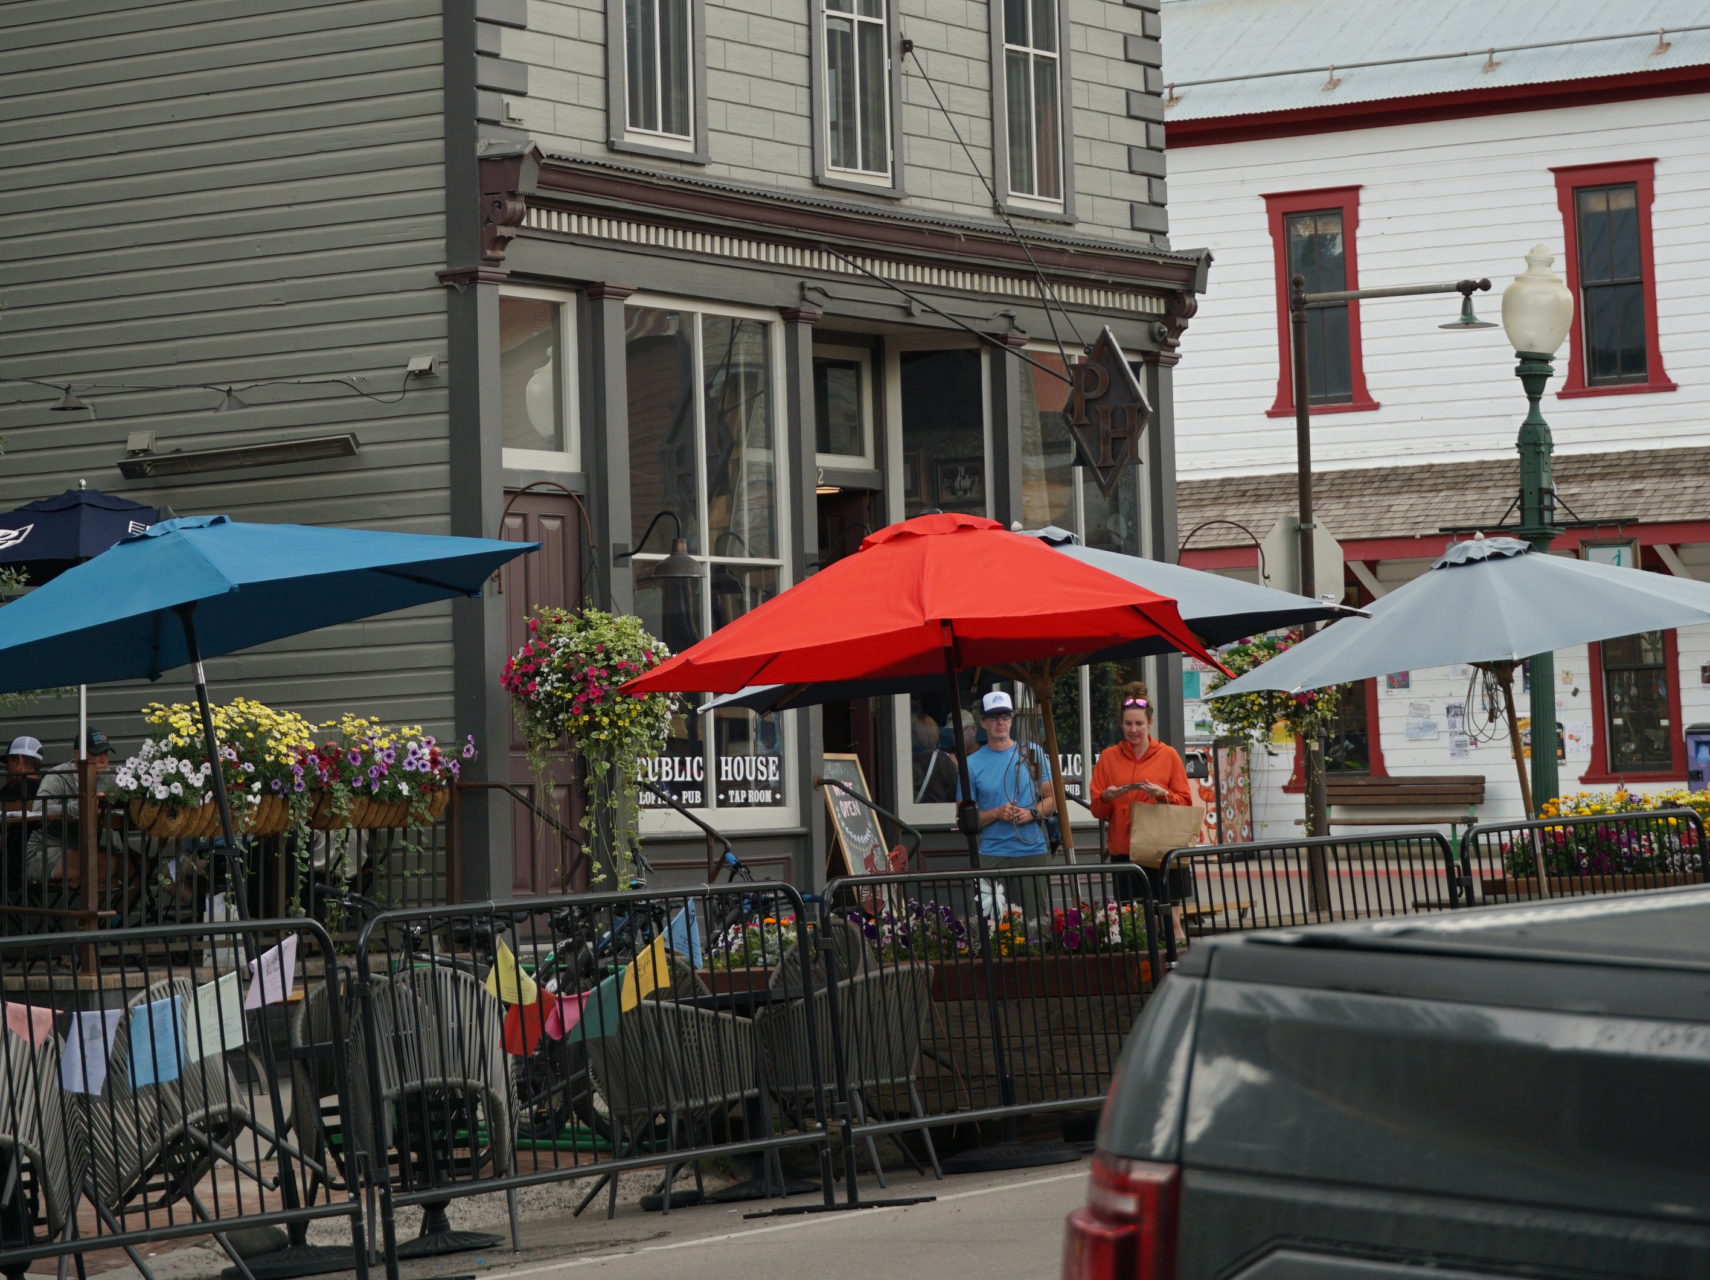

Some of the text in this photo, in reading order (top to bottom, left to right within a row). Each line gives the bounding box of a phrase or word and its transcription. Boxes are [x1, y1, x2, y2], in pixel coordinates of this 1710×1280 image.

[637, 756, 779, 781] PUBLIC HOUSE
[682, 790, 702, 803] PUB
[729, 790, 746, 802] TAP
[748, 790, 772, 802] ROOM
[840, 800, 861, 818] OPEN
